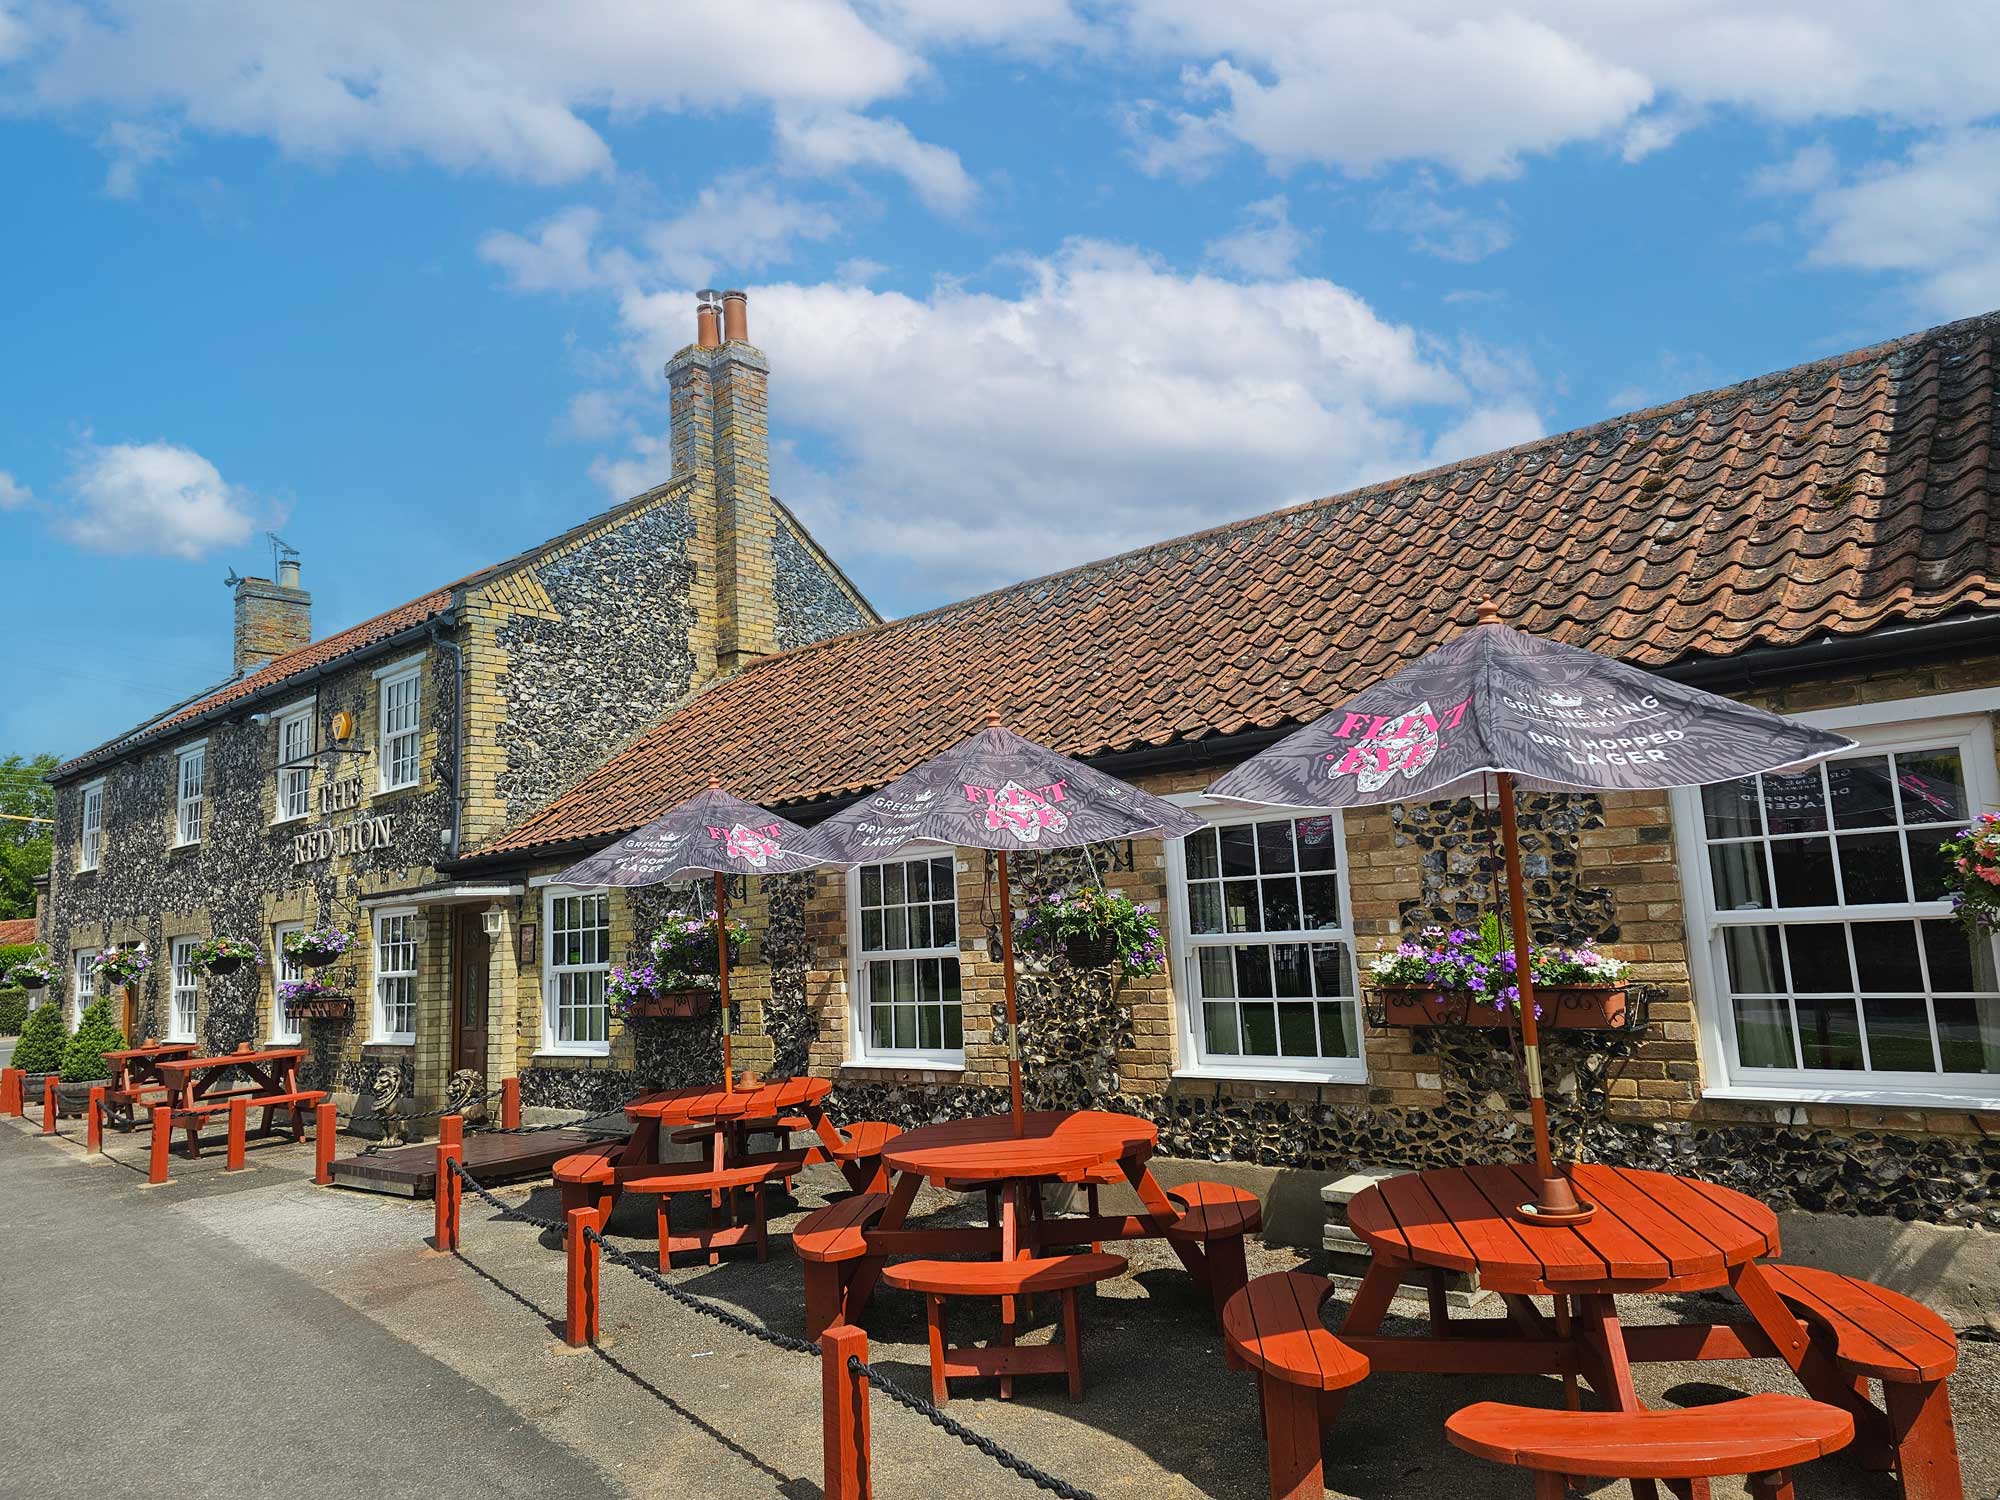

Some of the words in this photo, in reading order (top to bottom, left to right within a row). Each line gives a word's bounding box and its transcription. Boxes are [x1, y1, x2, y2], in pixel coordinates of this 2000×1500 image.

[1503, 696, 1589, 719] GREENE
[1599, 695, 1659, 718] KING
[1333, 694, 1475, 740] FLINT
[1555, 719, 1616, 729] BREWERY
[1528, 730, 1572, 748] DRY
[1581, 730, 1684, 750] HOPPED
[1567, 749, 1670, 766] LAGER
[318, 775, 361, 814] THE
[962, 779, 1068, 806] FLINT
[875, 797, 923, 812] GREENE
[705, 823, 781, 843] FLINT
[857, 823, 884, 834] DRY
[292, 829, 334, 866] RED
[339, 814, 395, 856] LION
[626, 840, 670, 848] GREENE
[861, 835, 905, 847] LAGER
[620, 863, 665, 873] LAGER
